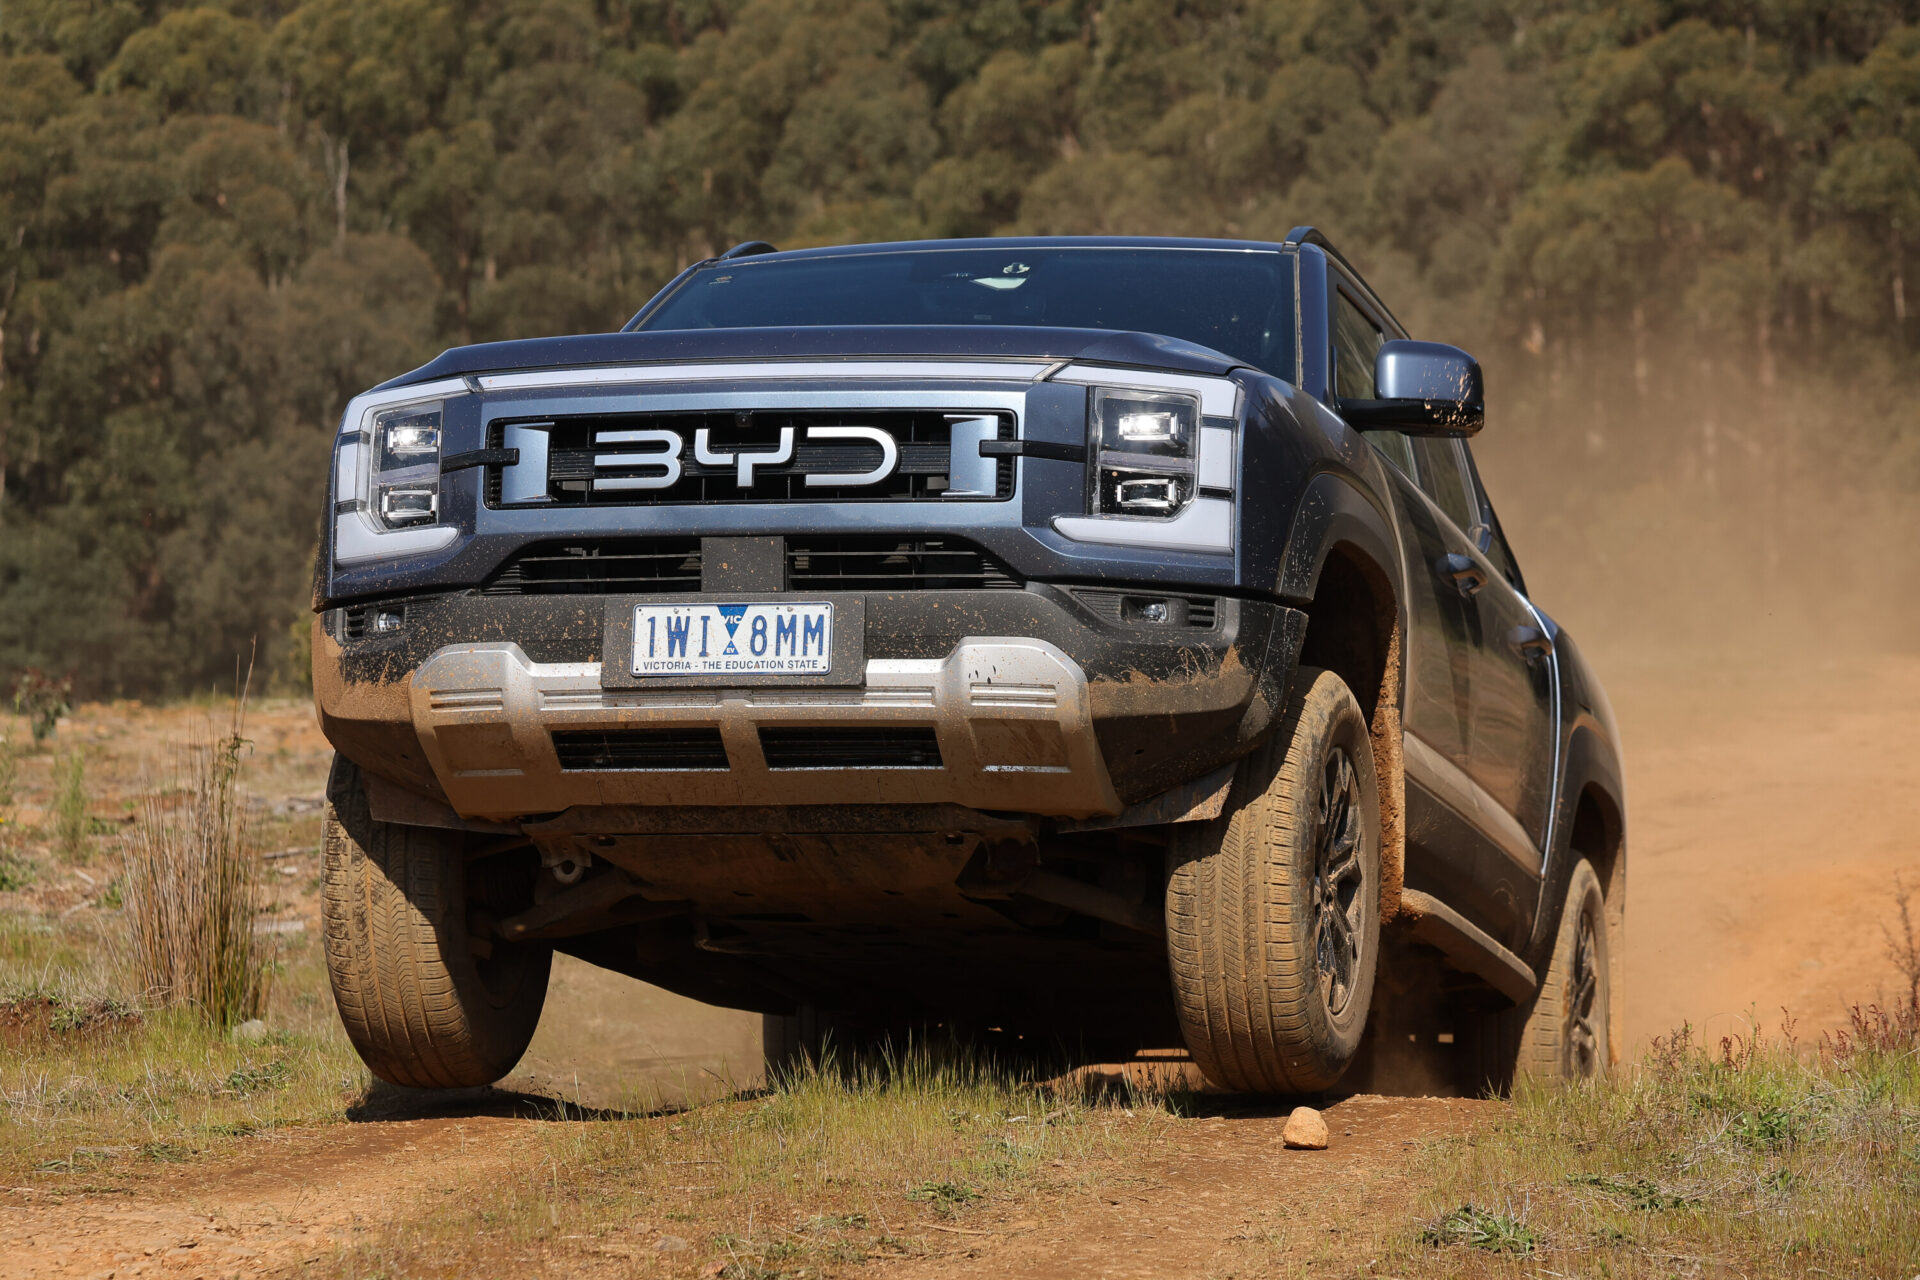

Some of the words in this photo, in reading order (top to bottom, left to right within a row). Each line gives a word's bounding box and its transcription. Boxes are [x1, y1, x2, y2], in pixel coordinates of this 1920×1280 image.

[593, 426, 898, 491] BYD
[723, 614, 743, 624] VIC
[750, 614, 825, 657] 8MM
[643, 661, 691, 670] VICTORIA
[702, 661, 722, 670] THE
[725, 660, 784, 670] EDUCATION
[787, 659, 818, 669] STATE
